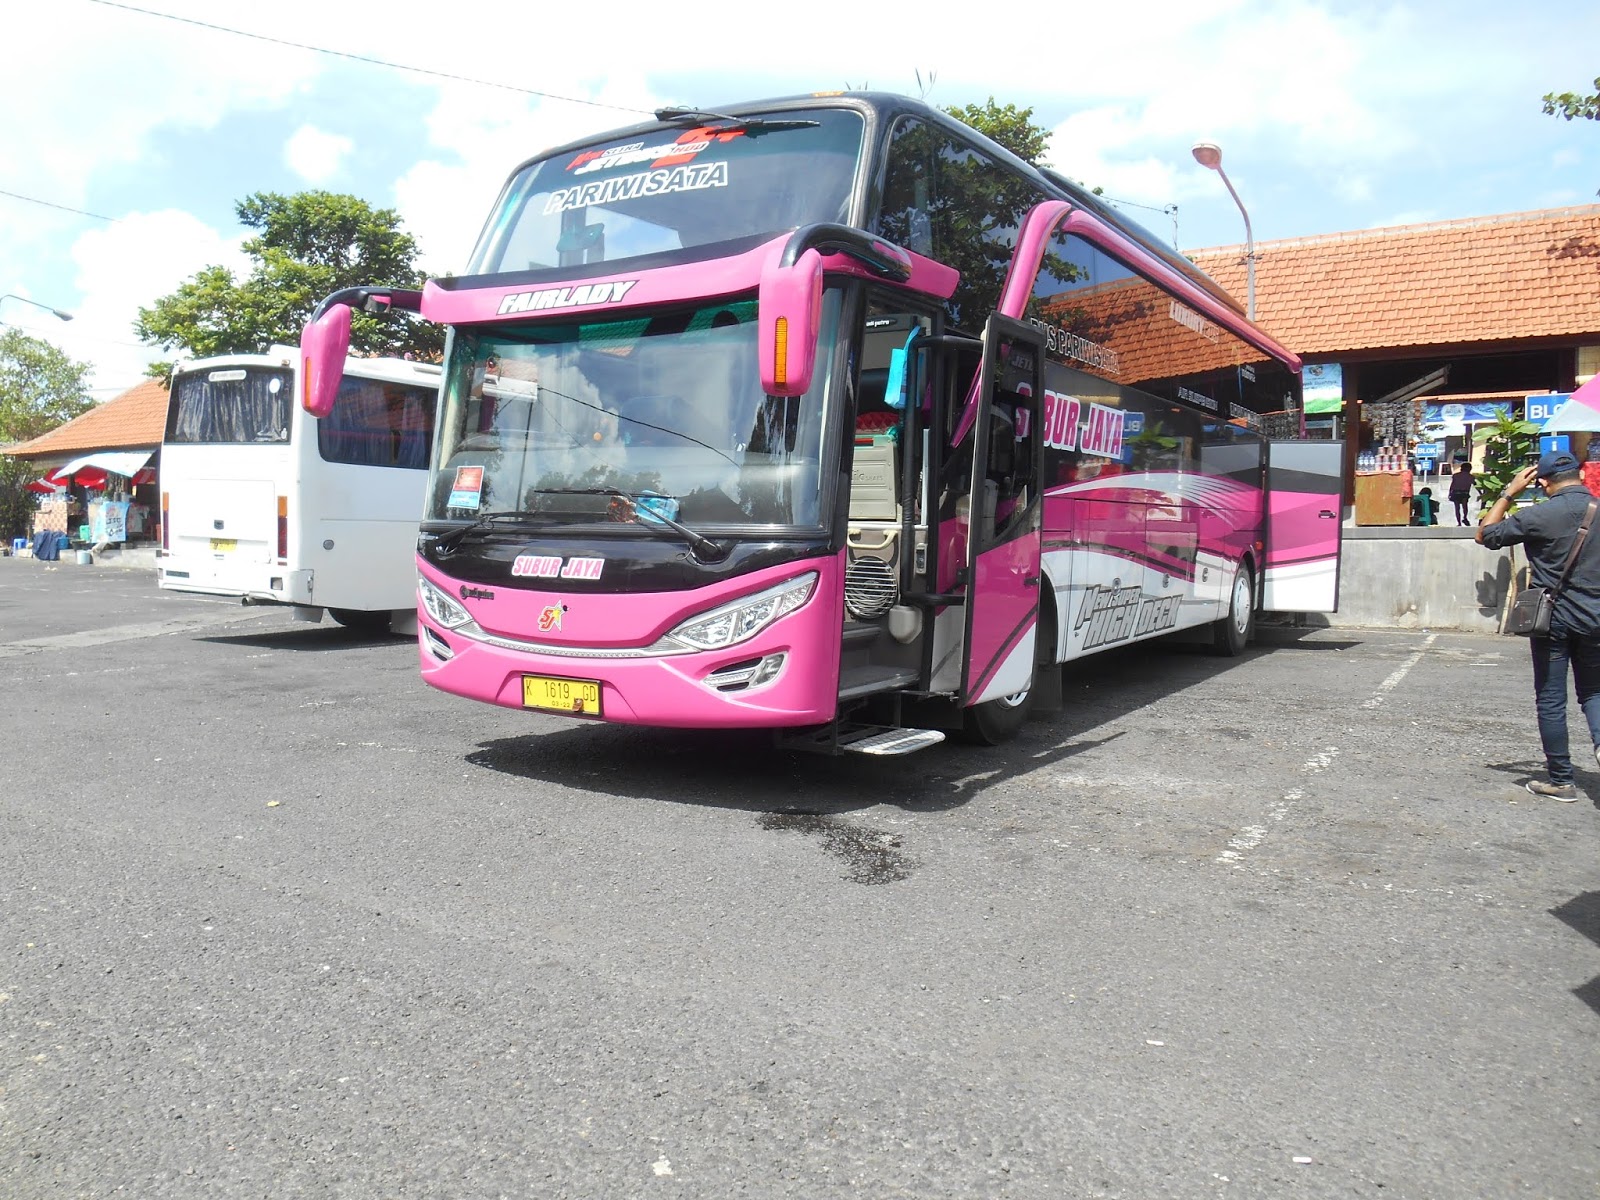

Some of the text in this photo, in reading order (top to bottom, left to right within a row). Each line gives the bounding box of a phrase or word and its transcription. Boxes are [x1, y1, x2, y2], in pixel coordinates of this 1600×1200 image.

[543, 161, 728, 216] PARIWISATA
[496, 280, 640, 316] FAIRLADY
[1058, 328, 1120, 374] PARIWISATA
[1081, 403, 1125, 459] JAYA
[1422, 461, 1430, 469] E
[512, 556, 605, 579] SUBUR JAYA
[1082, 594, 1183, 650] HIGH DECK
[526, 680, 596, 701] K 1619 GD
